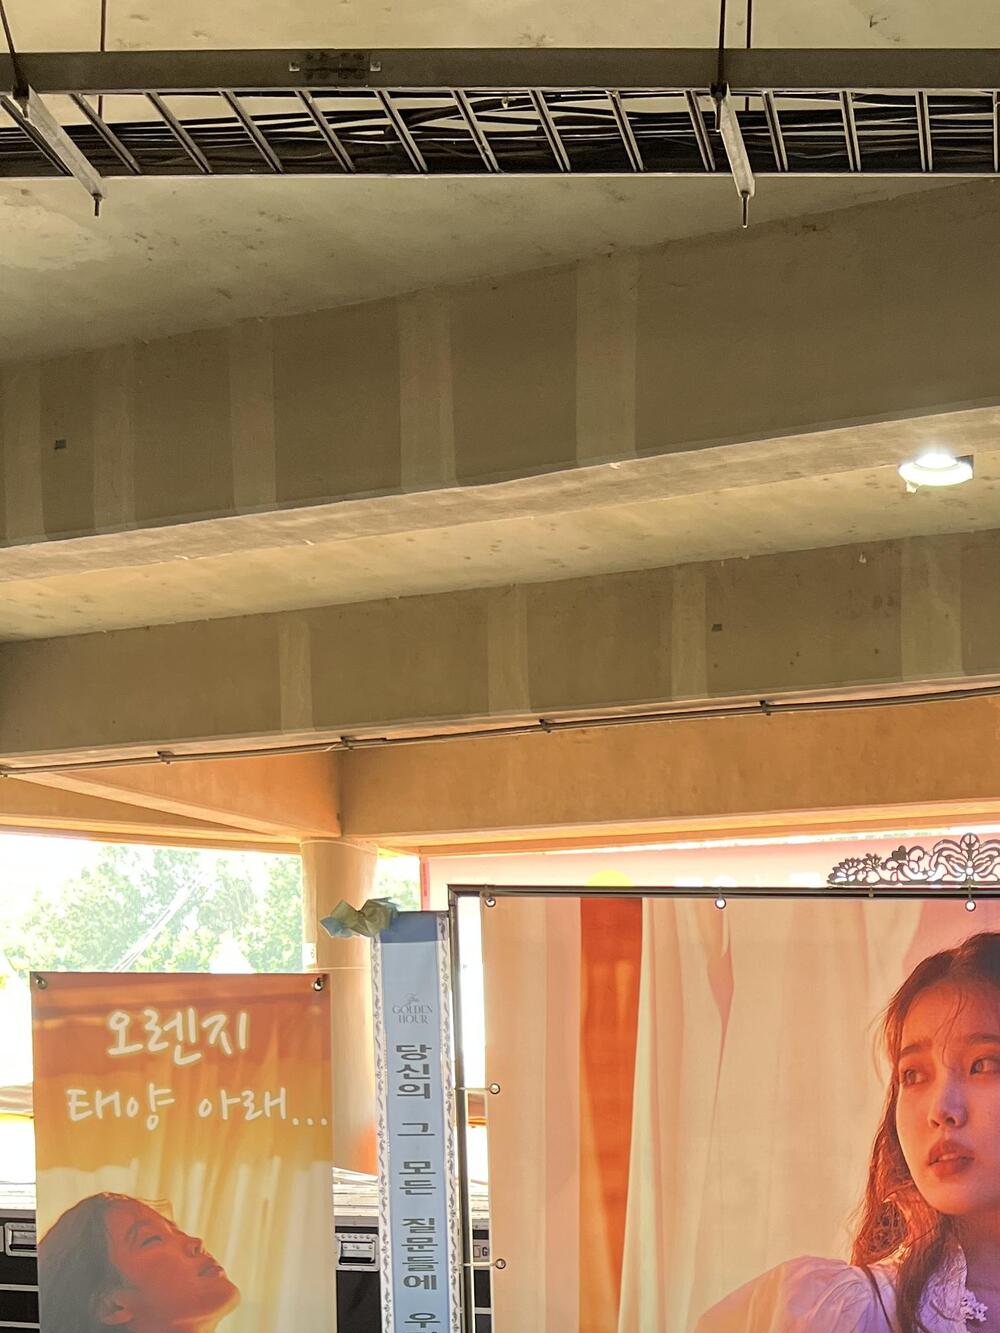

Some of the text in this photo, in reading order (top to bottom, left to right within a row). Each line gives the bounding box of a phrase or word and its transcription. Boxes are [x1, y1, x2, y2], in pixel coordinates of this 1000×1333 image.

[107, 1007, 247, 1066] 오렌지
[398, 1015, 429, 1024] HOUR
[396, 1044, 433, 1100] 당신의
[66, 1083, 328, 1130] 태양 아래...
[397, 1122, 436, 1137] 그
[398, 1161, 437, 1196] 모든
[401, 1217, 439, 1290] 질문들에
